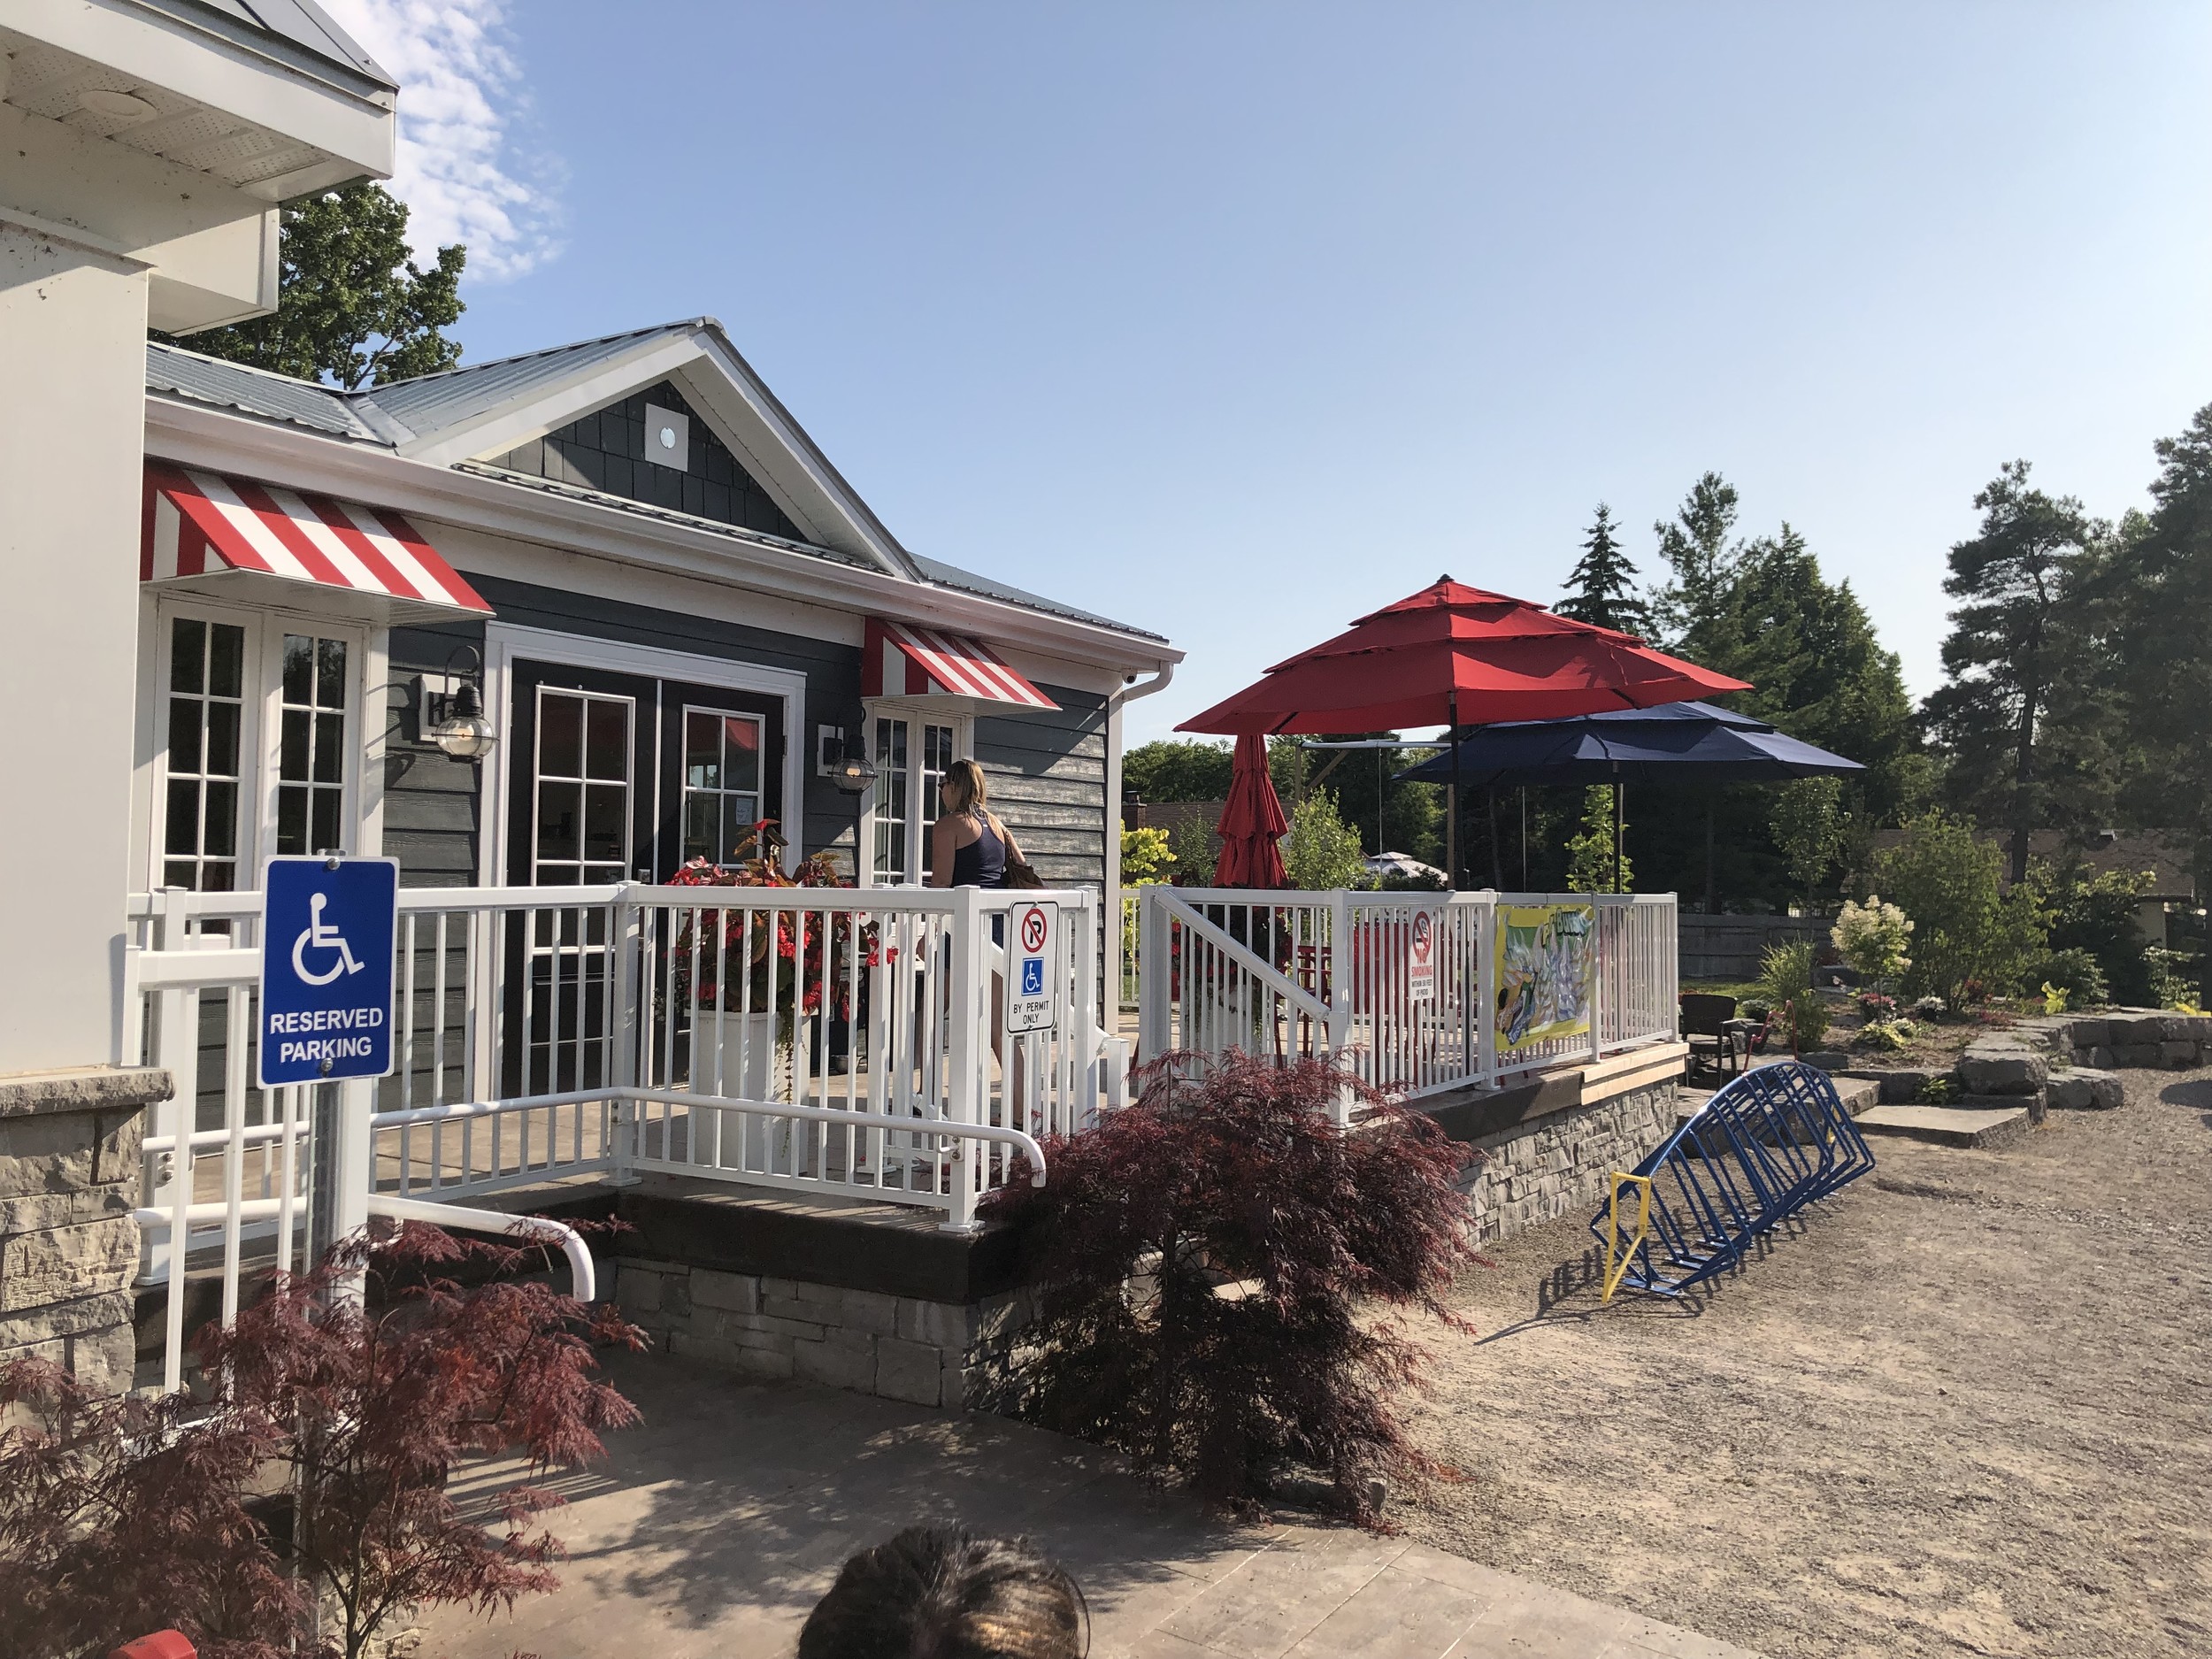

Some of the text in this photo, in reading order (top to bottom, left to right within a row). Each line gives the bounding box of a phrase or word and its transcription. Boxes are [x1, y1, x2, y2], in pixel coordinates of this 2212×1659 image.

[1417, 948, 1427, 964] NO
[1411, 965, 1432, 977] SMOKING
[1013, 1001, 1049, 1014] BY PERMIT
[270, 1008, 383, 1034] RESERVED
[1023, 1013, 1040, 1025] ONLY
[280, 1037, 373, 1063] PARKING
